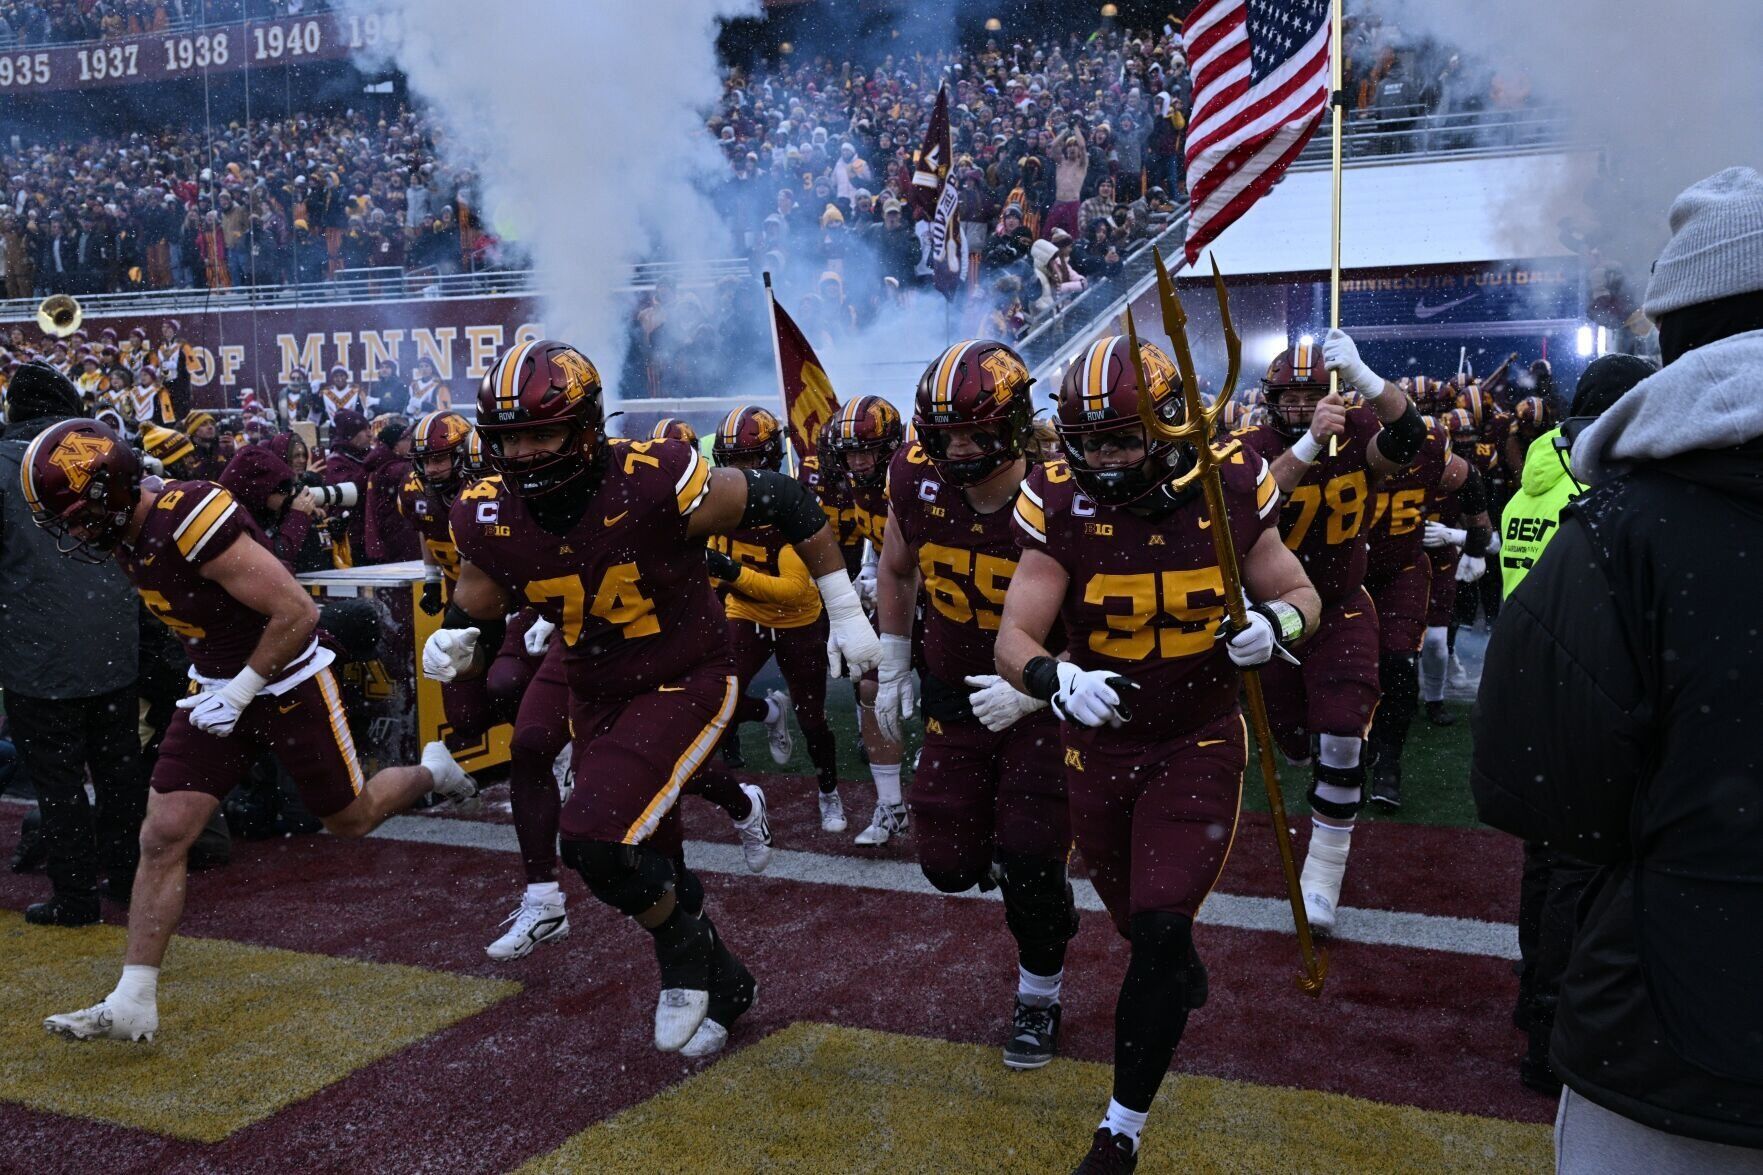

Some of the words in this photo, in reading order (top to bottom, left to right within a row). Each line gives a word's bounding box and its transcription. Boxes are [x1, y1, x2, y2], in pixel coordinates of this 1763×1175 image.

[77, 45, 139, 80] 1937
[165, 33, 228, 70] 1938
[254, 21, 320, 59] 1940
[350, 10, 402, 47] 194
[190, 345, 245, 386] OF
[498, 412, 515, 420] ROW
[935, 415, 949, 423] ROW
[1087, 410, 1105, 421] ROW
[918, 479, 940, 502] C
[478, 503, 499, 522] C
[1072, 494, 1096, 516] C
[1283, 470, 1368, 550] 78
[524, 562, 661, 647] 74
[1084, 566, 1225, 660] 35
